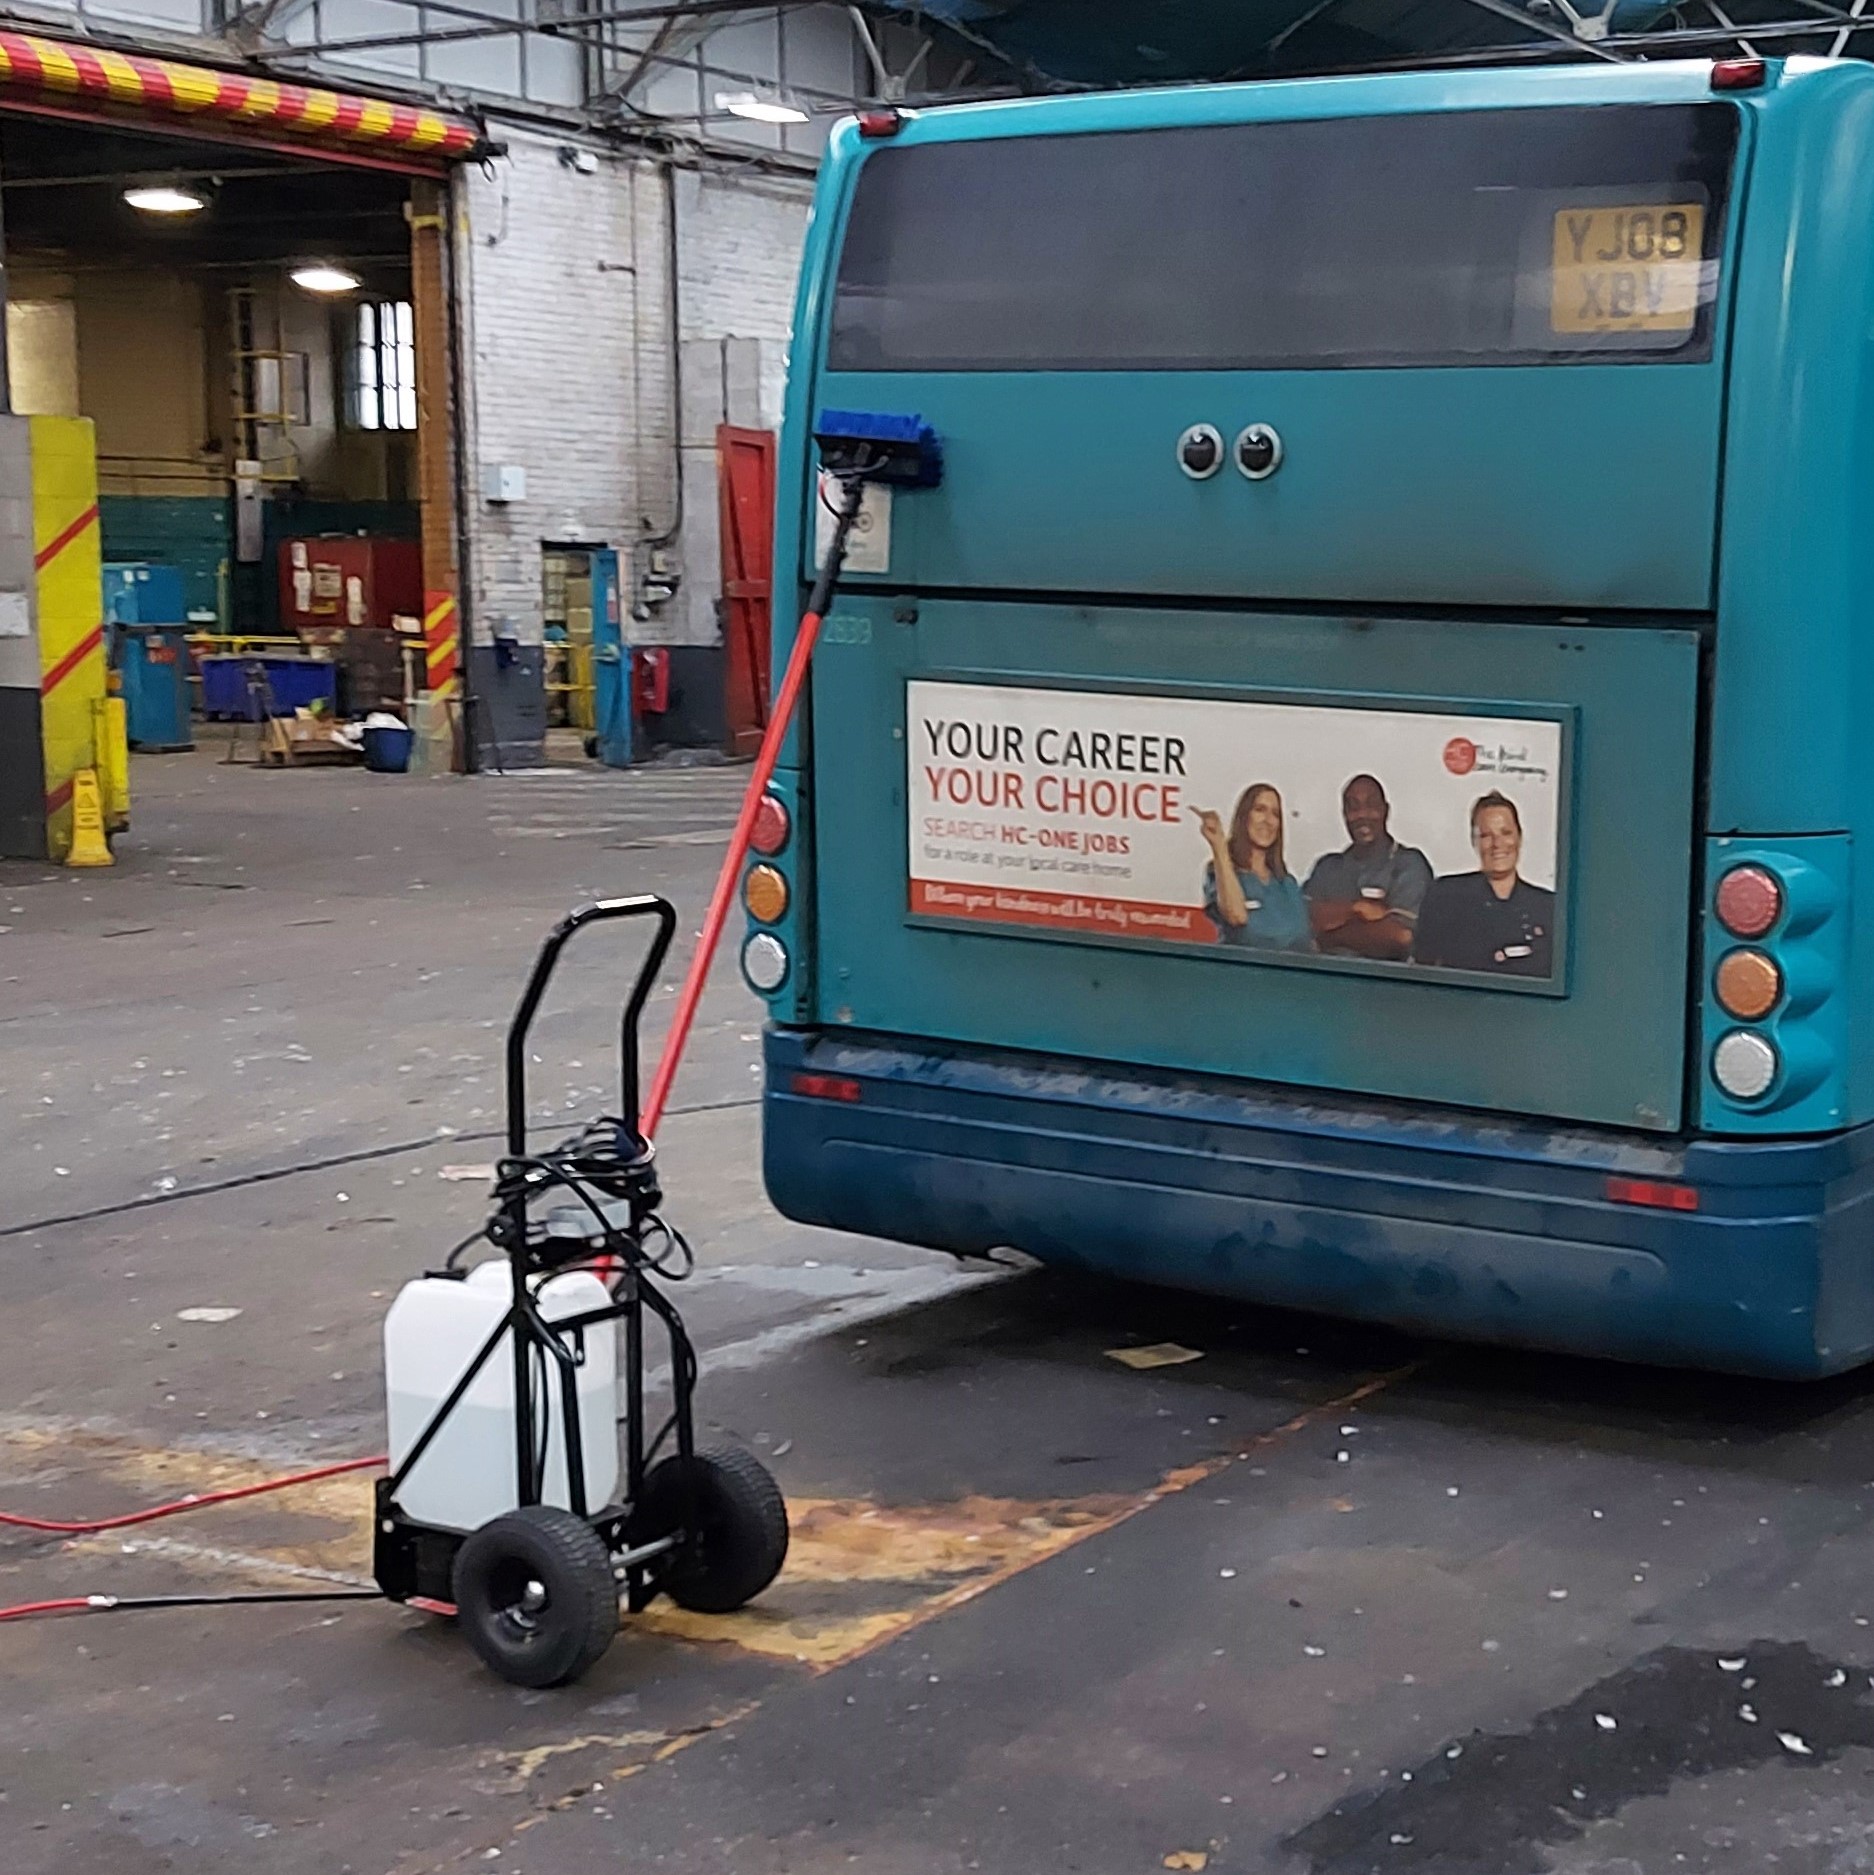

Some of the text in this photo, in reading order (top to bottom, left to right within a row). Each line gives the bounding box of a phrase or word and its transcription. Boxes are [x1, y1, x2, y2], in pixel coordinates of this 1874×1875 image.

[923, 718, 1187, 777] YOUR CAREER
[924, 766, 1183, 824] YOUR CHOICE
[923, 817, 1131, 855] SEARCH HC-ONE JOBS
